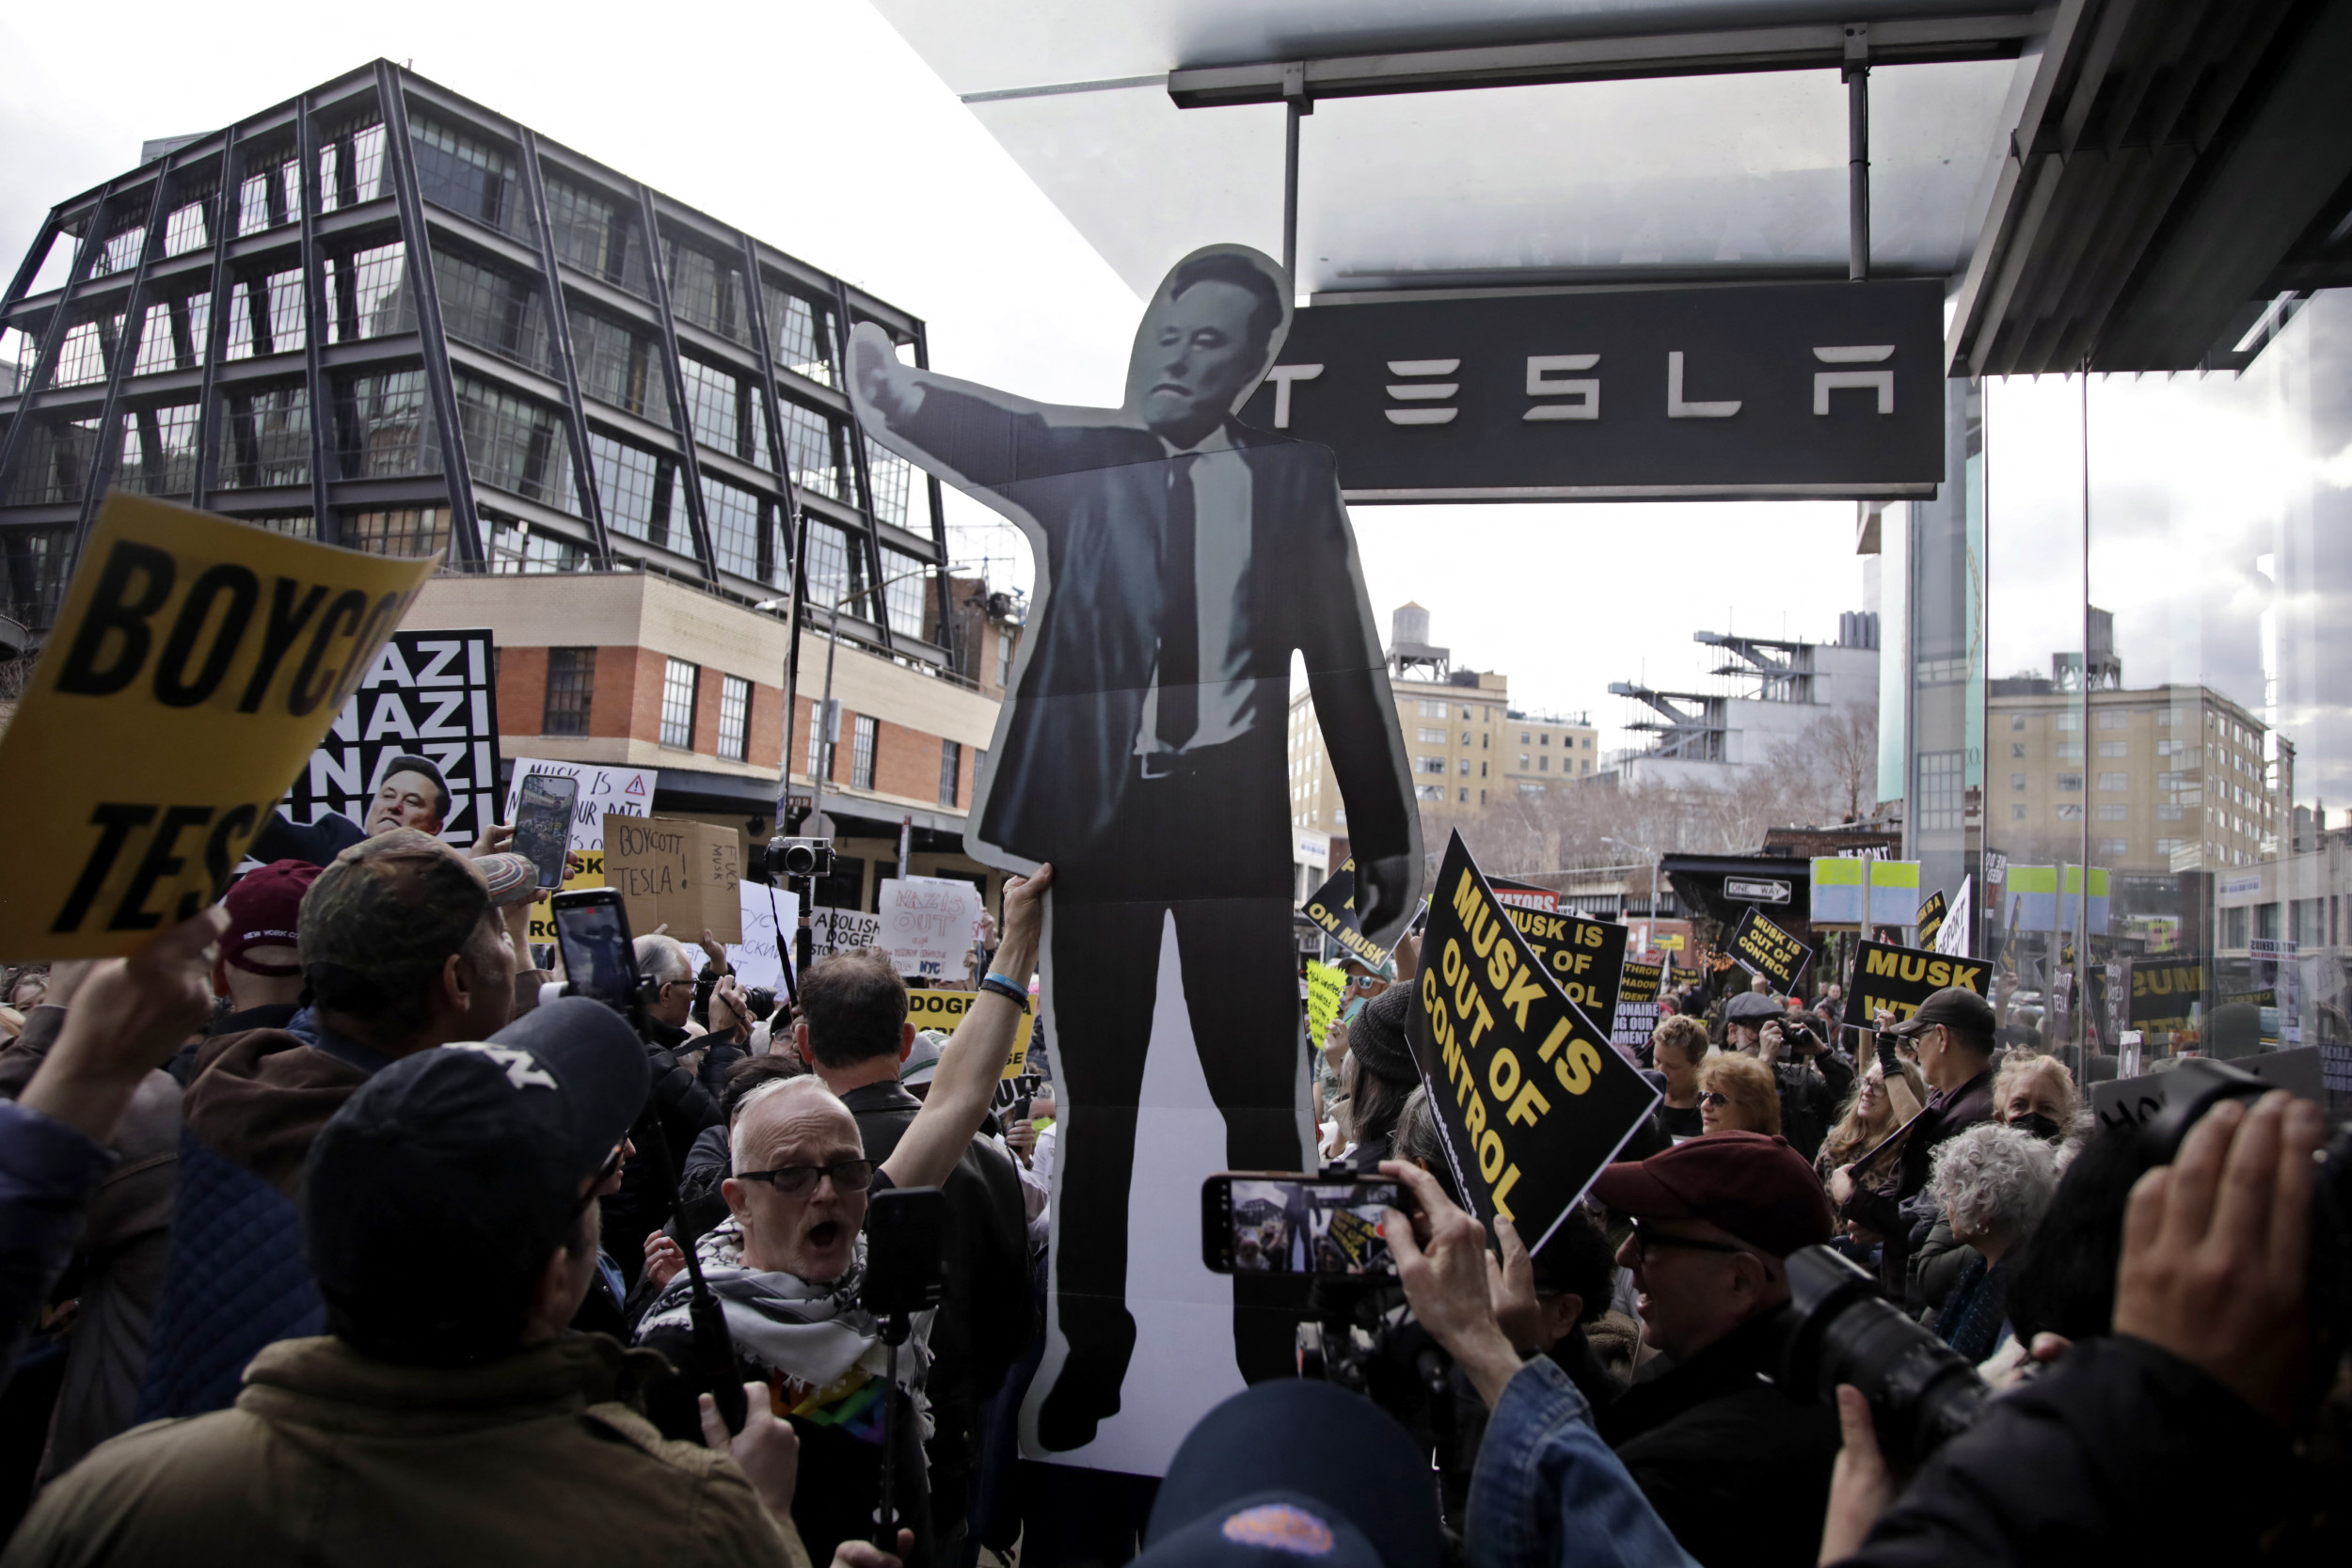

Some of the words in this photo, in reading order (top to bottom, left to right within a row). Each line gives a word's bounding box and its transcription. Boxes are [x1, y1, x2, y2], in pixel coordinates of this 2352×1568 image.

[1264, 343, 1897, 429] TESLA
[54, 540, 412, 718] BOYCO
[361, 639, 487, 689] AZI
[572, 800, 597, 826] OUR
[618, 824, 685, 857] BOYCOTT
[49, 801, 263, 934] TES
[711, 843, 723, 881] MUSK
[724, 844, 739, 893] FUCK
[896, 890, 966, 916] NAZIS
[1731, 883, 1750, 894] ONE
[1760, 885, 1782, 895] WAY
[263, 929, 289, 938] YORK
[814, 912, 881, 936] ABOLISH
[892, 911, 958, 938] OUT
[1308, 902, 1342, 933] ON
[1338, 927, 1388, 965] MUSK
[1505, 908, 1568, 942] MUSK
[1574, 923, 1604, 948] IS
[1753, 914, 1787, 946] MUSK
[1786, 940, 1802, 956] IS
[811, 942, 838, 957] STO
[1552, 949, 1593, 975] OF
[1739, 936, 1791, 982] CONTROL
[1750, 928, 1774, 951] OUT
[1772, 947, 1793, 963] OF
[1452, 867, 1548, 1033] MUSK
[1537, 1016, 1602, 1096] IS
[1865, 948, 1982, 994] MUSK
[1616, 1003, 1659, 1017] ONAIRE
[1629, 1017, 1655, 1031] OUR
[1864, 994, 1922, 1024] WT
[1441, 939, 1494, 1048] OUT
[1489, 1047, 1551, 1128] OF
[1422, 967, 1521, 1223] CONTROL
